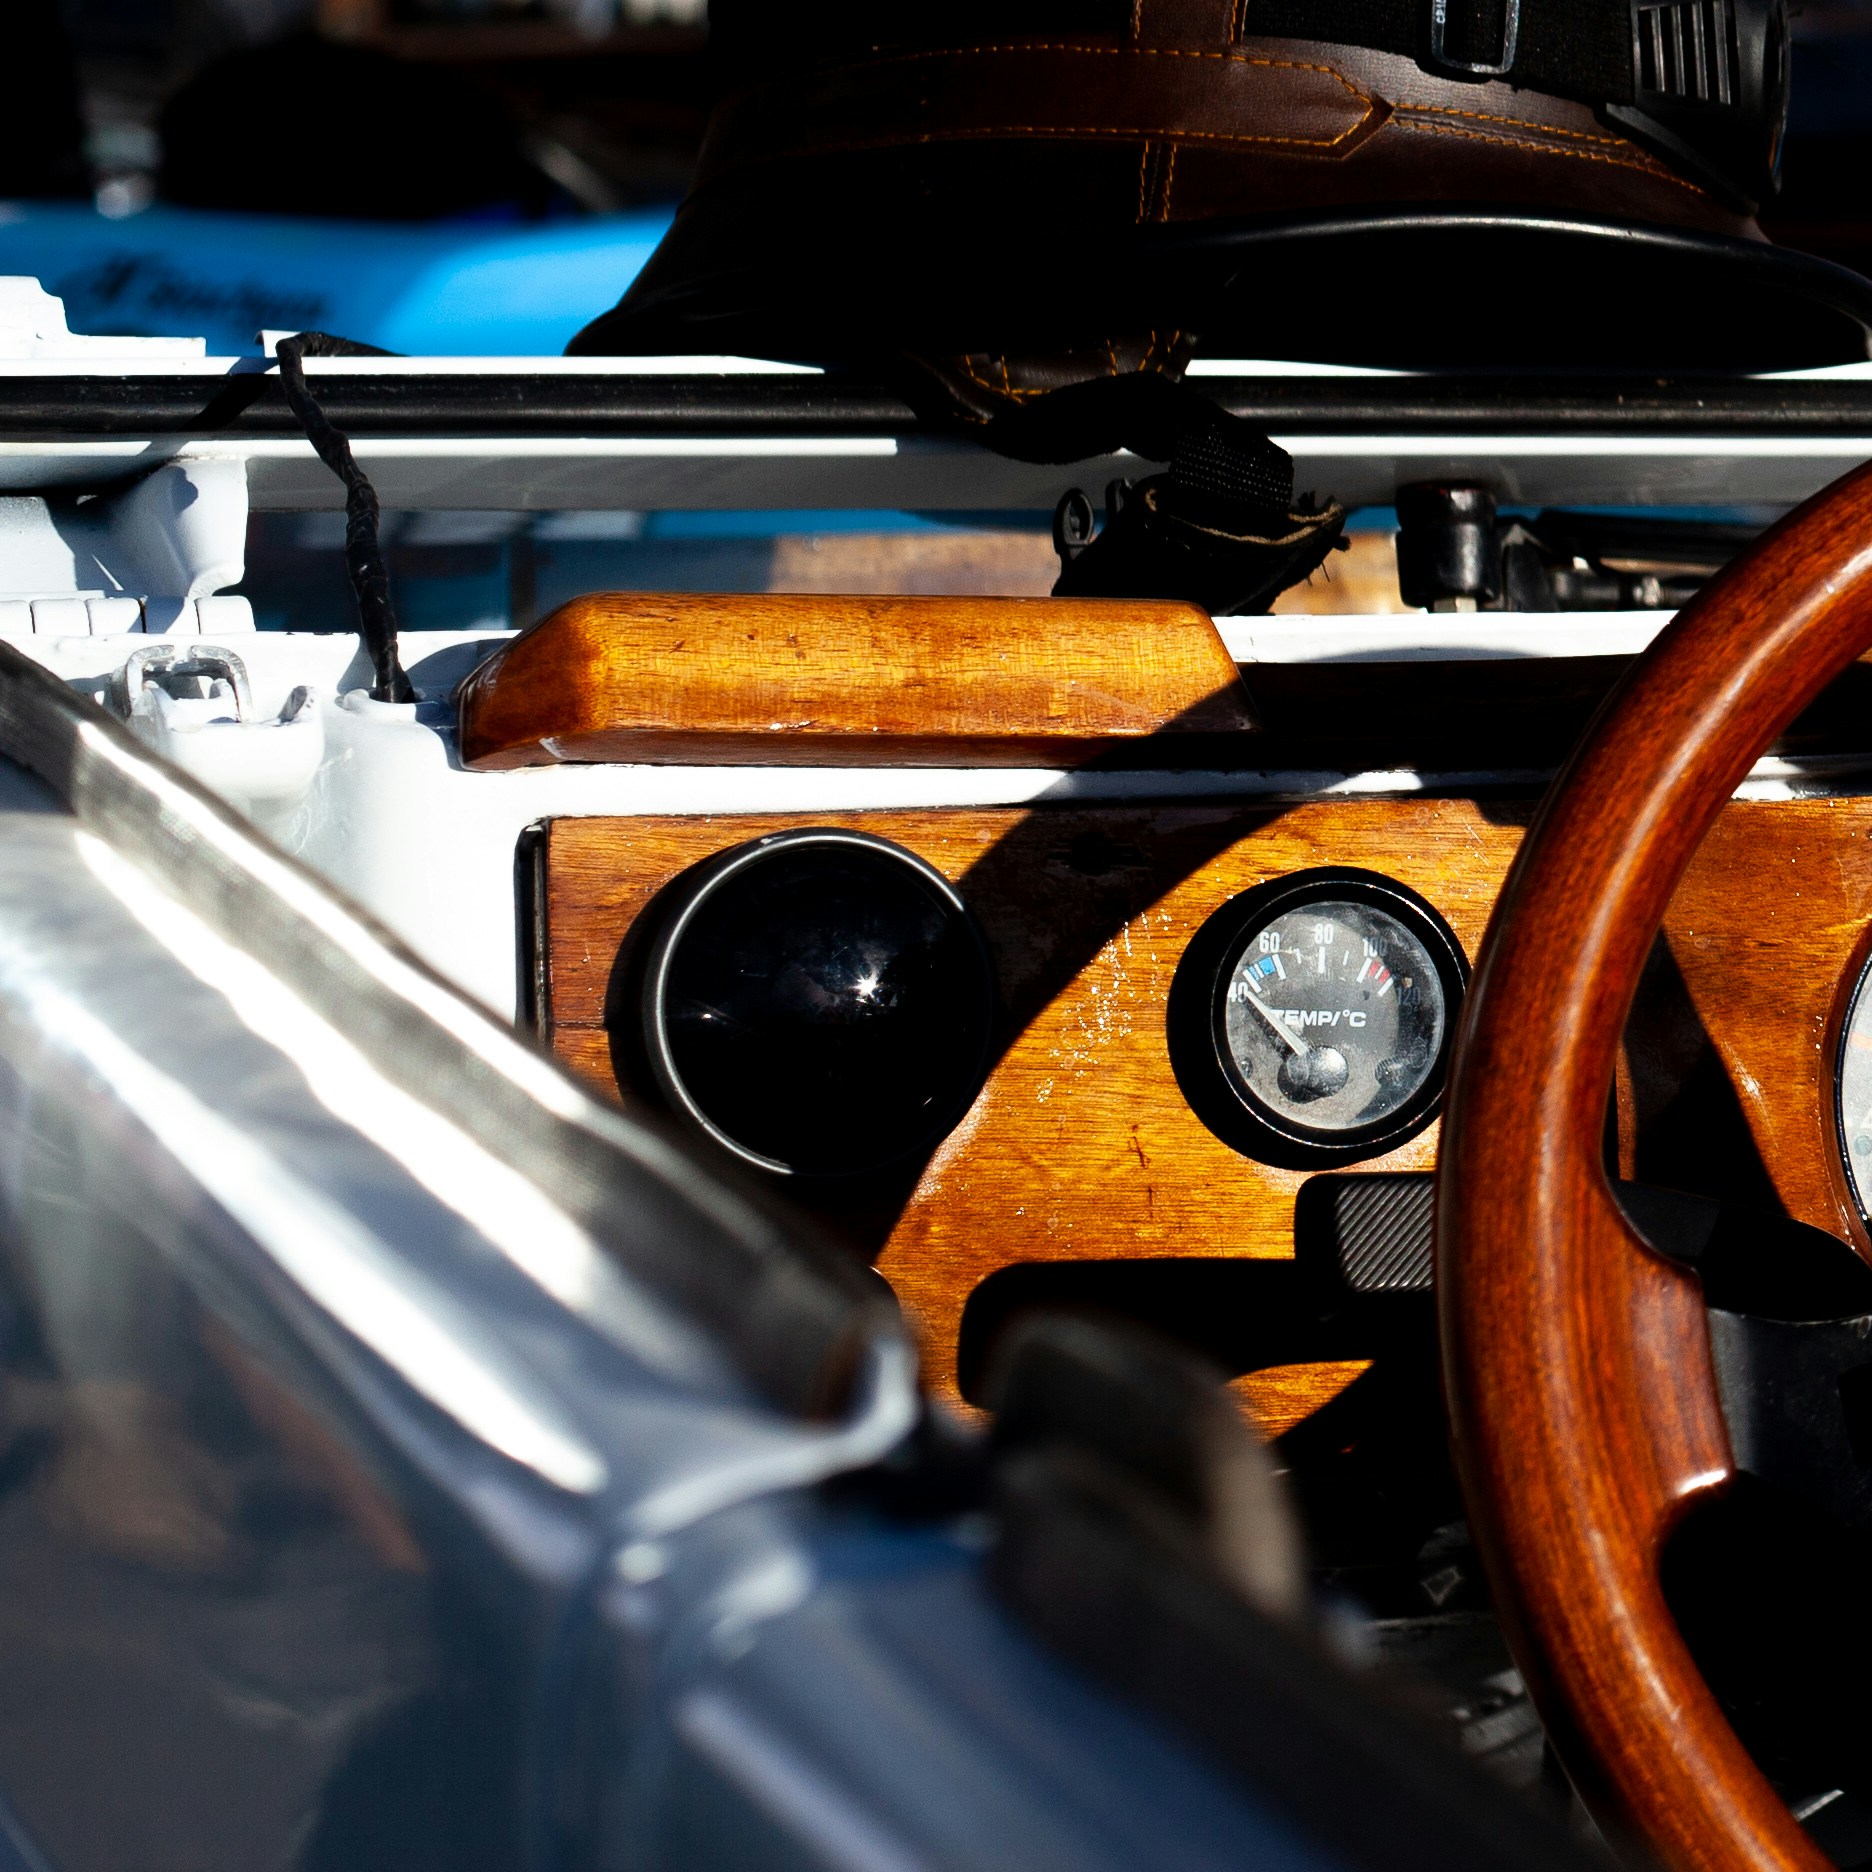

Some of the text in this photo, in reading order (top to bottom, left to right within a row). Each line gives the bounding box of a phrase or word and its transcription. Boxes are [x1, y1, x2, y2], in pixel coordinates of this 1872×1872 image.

[1259, 931, 1281, 953] 60
[1313, 923, 1334, 945] 80
[1362, 936, 1388, 957] 100
[1227, 981, 1249, 1003] 40
